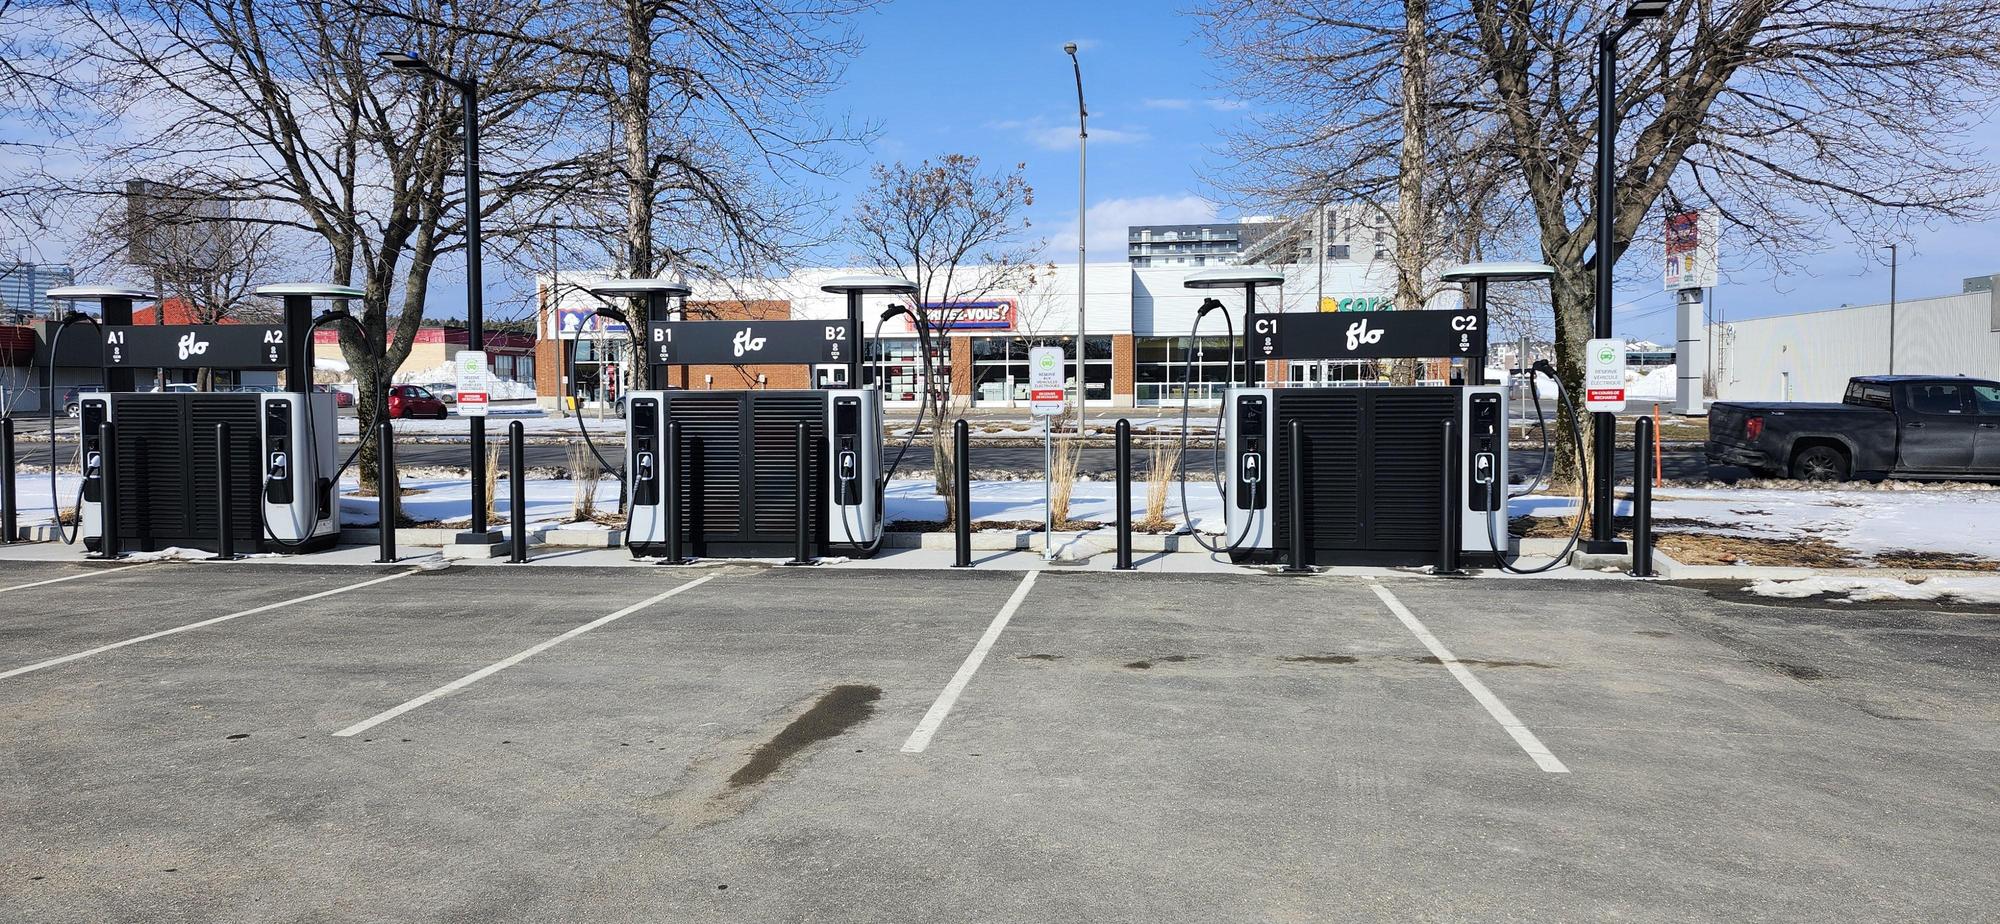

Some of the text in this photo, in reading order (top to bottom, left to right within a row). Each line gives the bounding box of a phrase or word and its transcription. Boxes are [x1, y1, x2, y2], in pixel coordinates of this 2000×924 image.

[1255, 319, 1277, 334] C1
[1451, 315, 1478, 331] C2
[107, 330, 124, 345] A1
[263, 329, 284, 344] A2
[653, 328, 672, 343] B1
[825, 326, 846, 341] B2
[1345, 318, 1386, 352] flo
[177, 331, 210, 361] flo
[732, 327, 767, 358] flo
